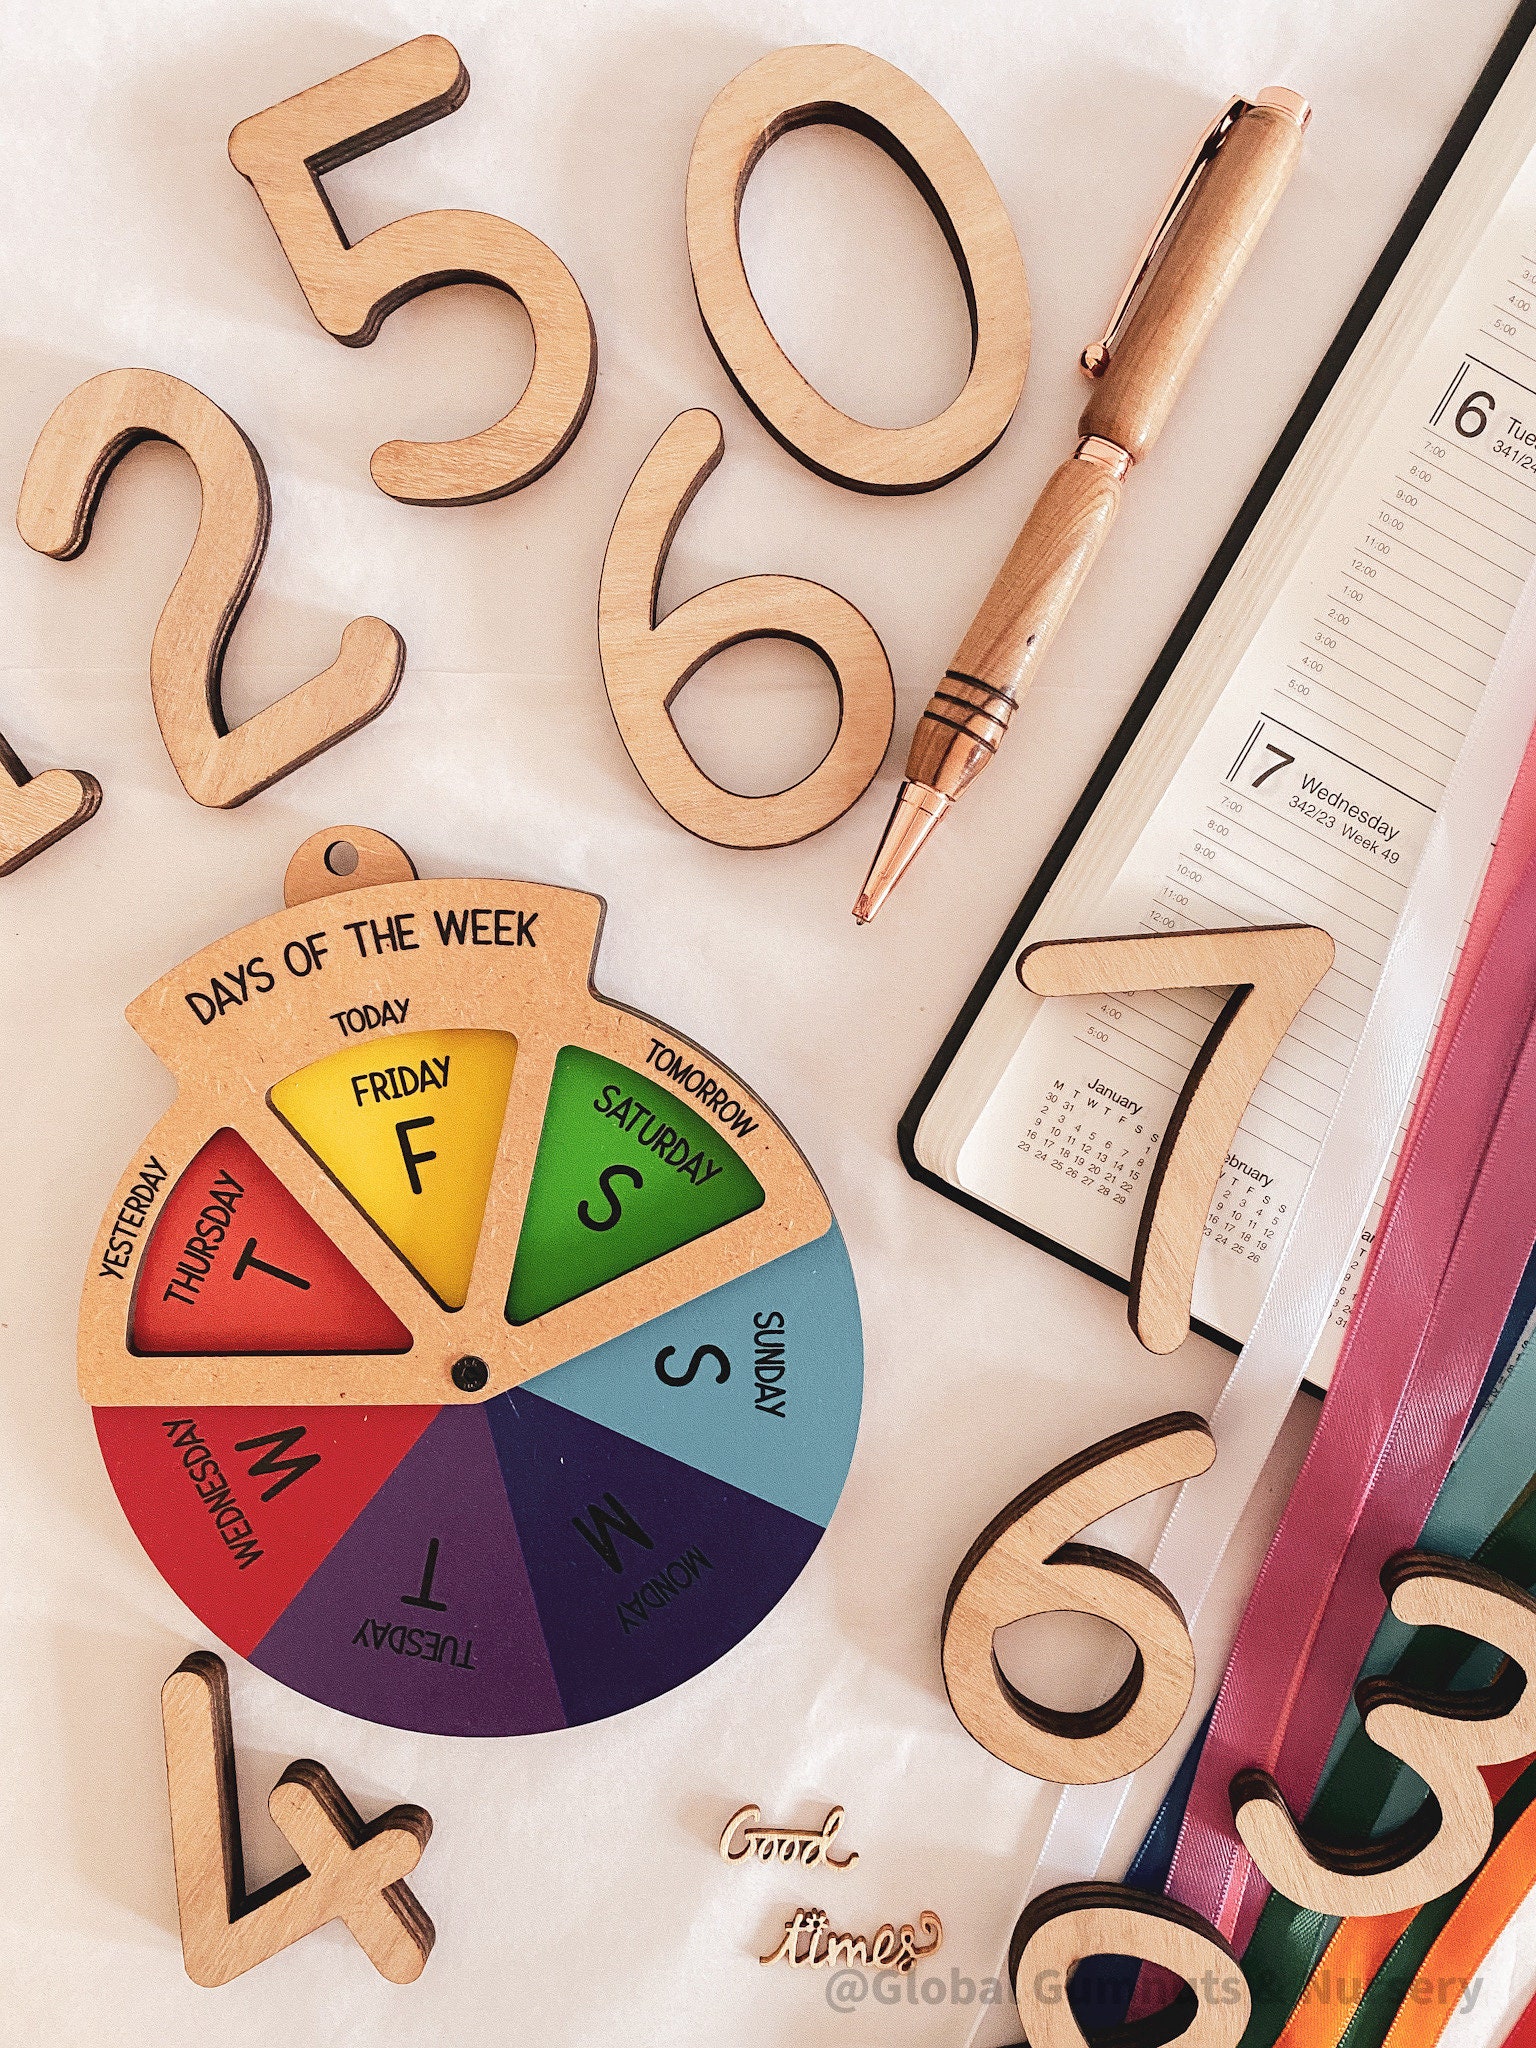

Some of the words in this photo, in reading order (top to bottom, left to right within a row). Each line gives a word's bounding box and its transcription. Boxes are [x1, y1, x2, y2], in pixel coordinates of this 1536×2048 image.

[228, 34, 599, 507] 5
[1509, 296, 1530, 311] 4:00
[1494, 319, 1516, 335] 5:00
[1455, 391, 1496, 438] 6
[1507, 417, 1536, 449] Tue
[1424, 442, 1446, 458] 7:00
[1410, 466, 1432, 482] 8:00
[1396, 490, 1417, 507] 9:00
[1378, 511, 1403, 531] 10:00
[1365, 535, 1390, 554] 11:00
[15, 367, 405, 809] 2
[1351, 559, 1377, 578] 12:00
[1343, 586, 1364, 601] 1:00
[597, 407, 895, 851] 6
[1328, 609, 1350, 625] 2:00
[1314, 632, 1336, 649] 3:00
[1302, 656, 1323, 673] 4:00
[1288, 680, 1310, 696] 5:00
[1252, 743, 1295, 788] 7
[1222, 796, 1242, 813] 7:00
[1302, 774, 1400, 842] Wednesday
[1208, 820, 1229, 836] 8:00
[1289, 796, 1336, 828] 342/23
[1342, 823, 1379, 854] Week
[1381, 849, 1399, 864] 49
[1176, 864, 1202, 882] 10:00
[1194, 843, 1215, 859] 9:00
[1163, 888, 1188, 905] 11:00
[1150, 911, 1174, 928] 12:00
[185, 957, 275, 1025] DAYS
[284, 931, 328, 977] OF
[344, 913, 419, 958] THE
[433, 908, 538, 948] WEEK
[330, 998, 410, 1036] TODAY
[1101, 1005, 1122, 1019] 4:00
[1087, 1027, 1108, 1042] 5:00
[351, 1055, 450, 1107] FRIDAY
[646, 1038, 759, 1138] TOMORROW
[1046, 1092, 1058, 1103] 30
[1063, 1102, 1074, 1112] 31
[1088, 1079, 1143, 1115] January
[1054, 1080, 1064, 1090] M
[1074, 1090, 1080, 1098] T
[1088, 1098, 1098, 1108] W
[1104, 1107, 1111, 1115] T
[1118, 1116, 1127, 1124] F
[1135, 1125, 1143, 1133] S
[1151, 1134, 1159, 1142] S
[395, 1116, 437, 1194] F
[593, 1085, 723, 1186] SATURDAY
[1016, 923, 1335, 1354] 7
[1035, 1118, 1042, 1126] 9
[1051, 1126, 1060, 1136] 10
[1068, 1136, 1076, 1145] 11
[1081, 1144, 1092, 1154] 12
[1097, 1152, 1107, 1162] 13
[1113, 1162, 1124, 1171] 14
[1129, 1170, 1140, 1180] 15
[1041, 1106, 1048, 1114] 2
[1058, 1115, 1065, 1123] 3
[1075, 1124, 1081, 1132] 4
[1089, 1132, 1096, 1140] 5
[1105, 1141, 1112, 1149] 6
[1122, 1149, 1129, 1157] 7
[1137, 1158, 1144, 1166] 8
[1018, 1141, 1030, 1152] 23
[1035, 1150, 1048, 1161] 24
[1051, 1160, 1064, 1170] 25
[1066, 1168, 1078, 1178] 26
[1081, 1176, 1094, 1186] 27
[1098, 1185, 1110, 1196] 28
[1113, 1194, 1126, 1204] 29
[1027, 1130, 1037, 1140] 16
[1044, 1139, 1054, 1148] 17
[1060, 1148, 1070, 1158] 18
[1074, 1156, 1084, 1166] 19
[1088, 1164, 1100, 1174] 20
[1104, 1173, 1116, 1183] 21
[1120, 1182, 1133, 1192] 22
[1225, 1154, 1273, 1188] ebruary
[577, 1165, 643, 1232] S
[1223, 1190, 1231, 1199] 2
[1239, 1199, 1246, 1207] 3
[1272, 1217, 1279, 1225] 5
[1232, 1177, 1239, 1185] T
[1263, 1196, 1271, 1204] S
[1279, 1205, 1286, 1213] S
[99, 1156, 168, 1279] YESTERDAY
[163, 1170, 244, 1304] THURSDAY
[1208, 1214, 1219, 1224] 16
[1224, 1223, 1235, 1231] 17
[1241, 1232, 1251, 1242] 18
[1257, 1241, 1267, 1250] 19
[1217, 1202, 1223, 1210] 9
[1232, 1210, 1242, 1220] 10
[1248, 1220, 1257, 1229] 11
[1264, 1229, 1274, 1239] 12
[233, 1238, 310, 1290] T
[1215, 1234, 1228, 1245] 24
[1231, 1243, 1244, 1254] 25
[1247, 1252, 1260, 1263] 26
[1351, 1261, 1358, 1269] 2
[1360, 1248, 1367, 1256] T
[1336, 1317, 1347, 1327] 31
[655, 1344, 731, 1388] S
[754, 1311, 786, 1418] SUNDAY
[234, 1425, 321, 1504] W
[162, 1419, 265, 1570] WEDNESDAY
[571, 1491, 655, 1575] M
[400, 1538, 446, 1611] T
[618, 1545, 714, 1635] MONDAY
[941, 1410, 1217, 1785] 6
[351, 1618, 476, 1670] TUESDAY
[1229, 1548, 1536, 1917] 3
[161, 1650, 436, 1988] 4
[719, 1804, 859, 1872] Good
[760, 1908, 943, 1975] times
